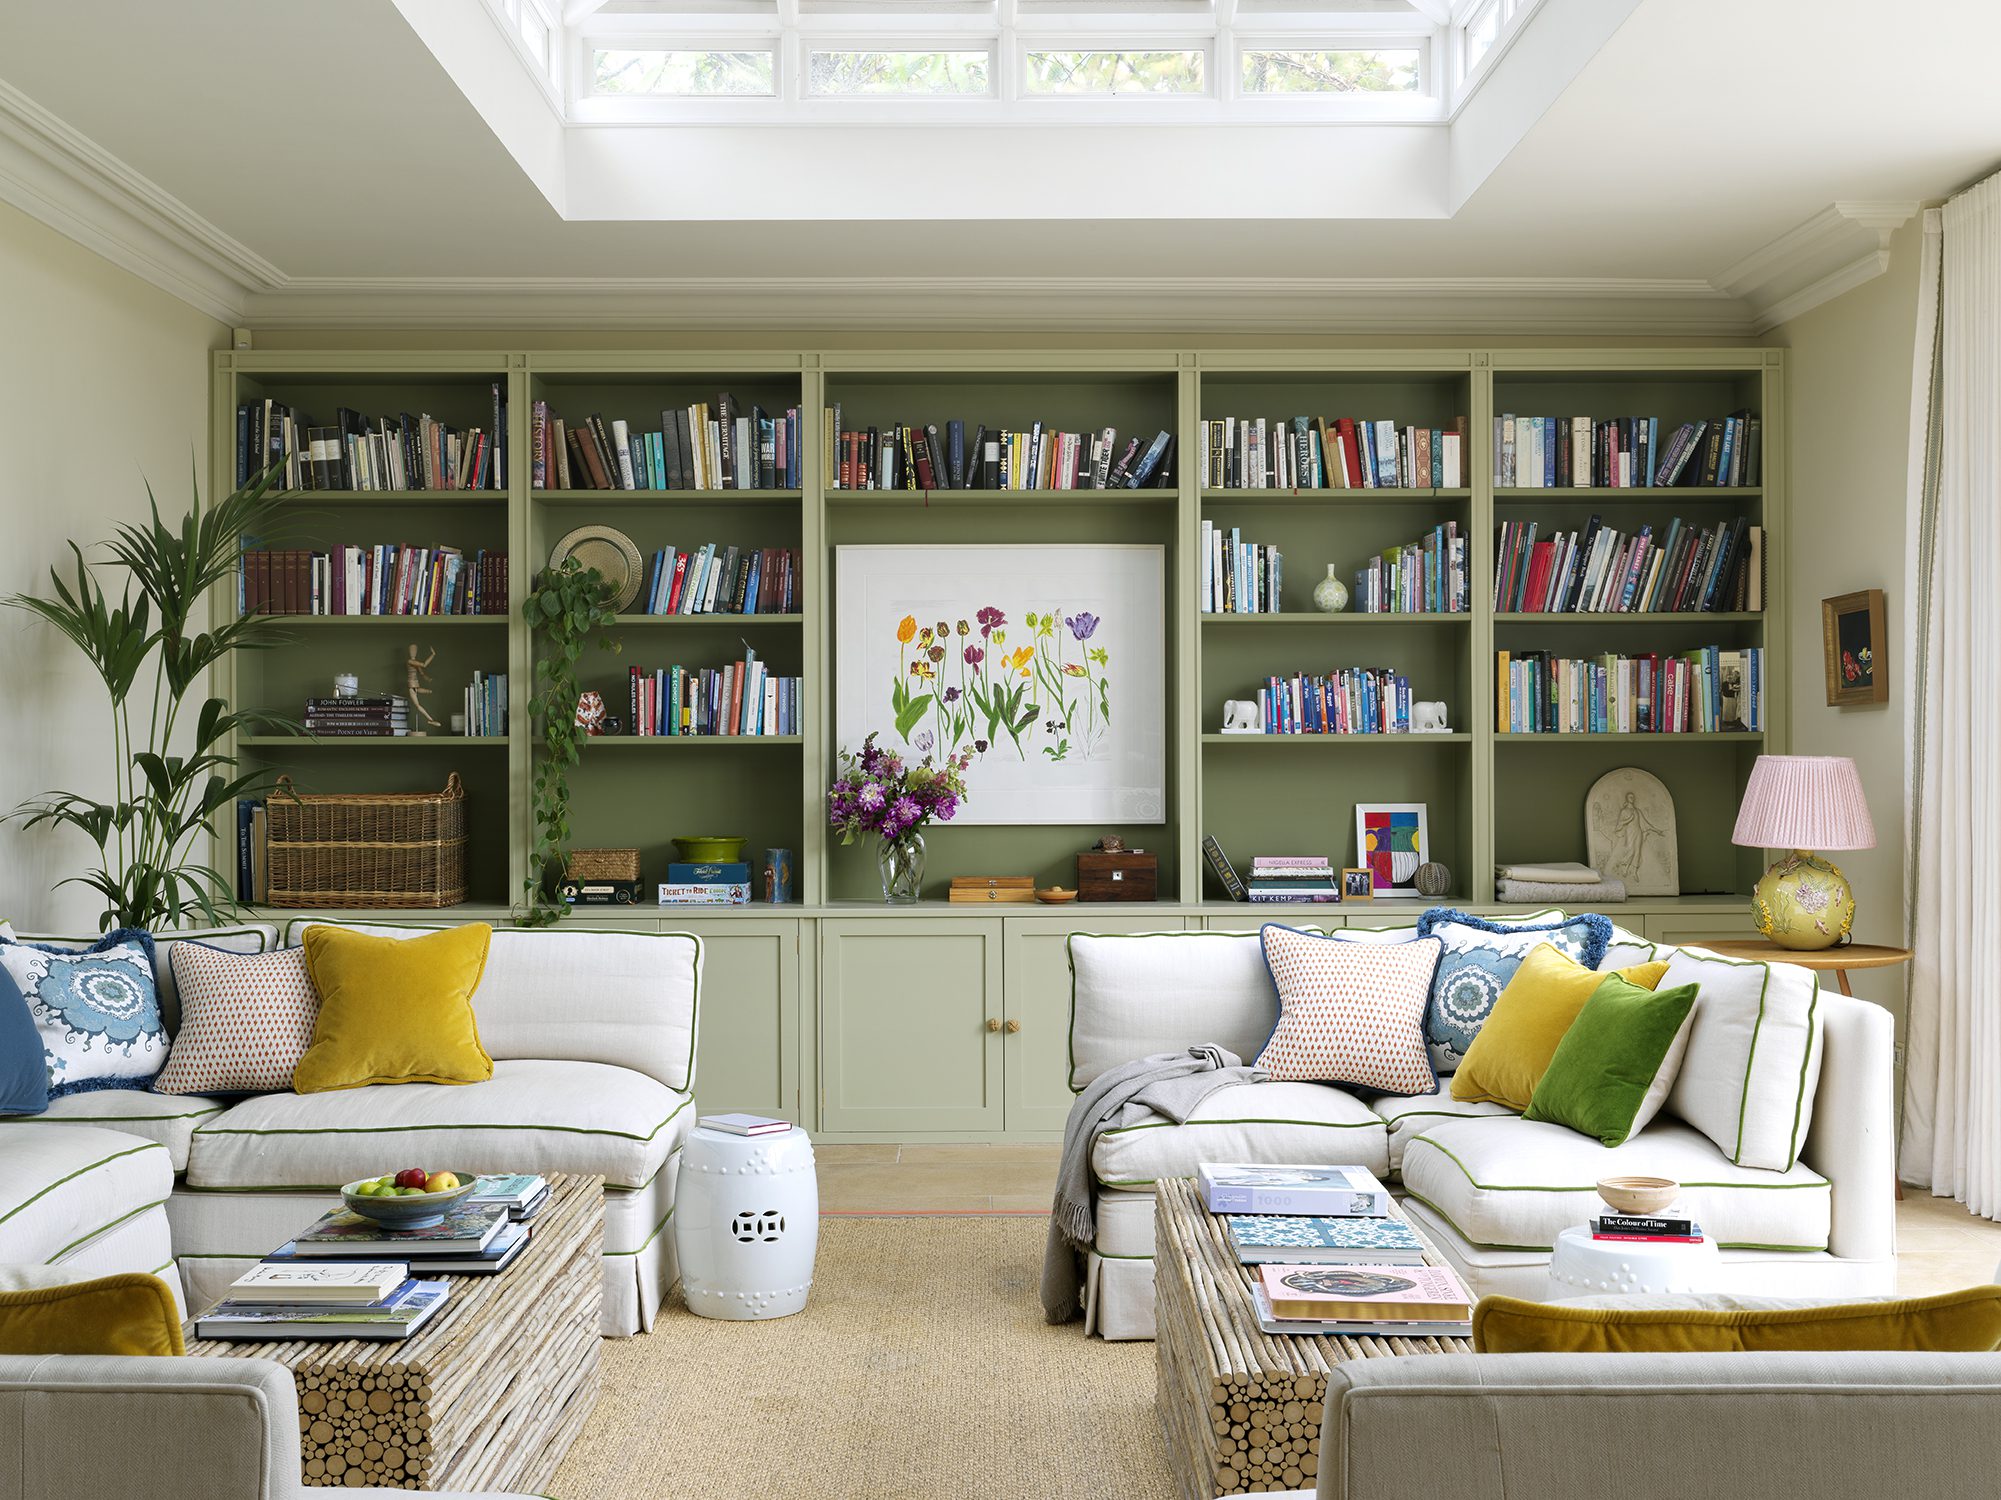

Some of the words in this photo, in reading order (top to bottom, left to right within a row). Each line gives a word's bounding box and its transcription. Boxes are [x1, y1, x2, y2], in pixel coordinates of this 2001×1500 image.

[534, 415, 543, 464] HISTORY
[721, 418, 730, 460] HERMITAGE
[761, 443, 775, 454] WAR
[1100, 448, 1110, 466] TIGER
[1299, 435, 1310, 477] HEROES
[1098, 466, 1108, 482] WHITE
[676, 555, 686, 573] 365
[1750, 684, 1758, 708] seafood
[240, 827, 247, 836] TO
[662, 886, 686, 896] TICKET
[692, 886, 709, 895] RIDE
[1258, 1196, 1292, 1206] 1000
[1617, 1218, 1640, 1226] Colour
[1649, 1220, 1667, 1228] Time
